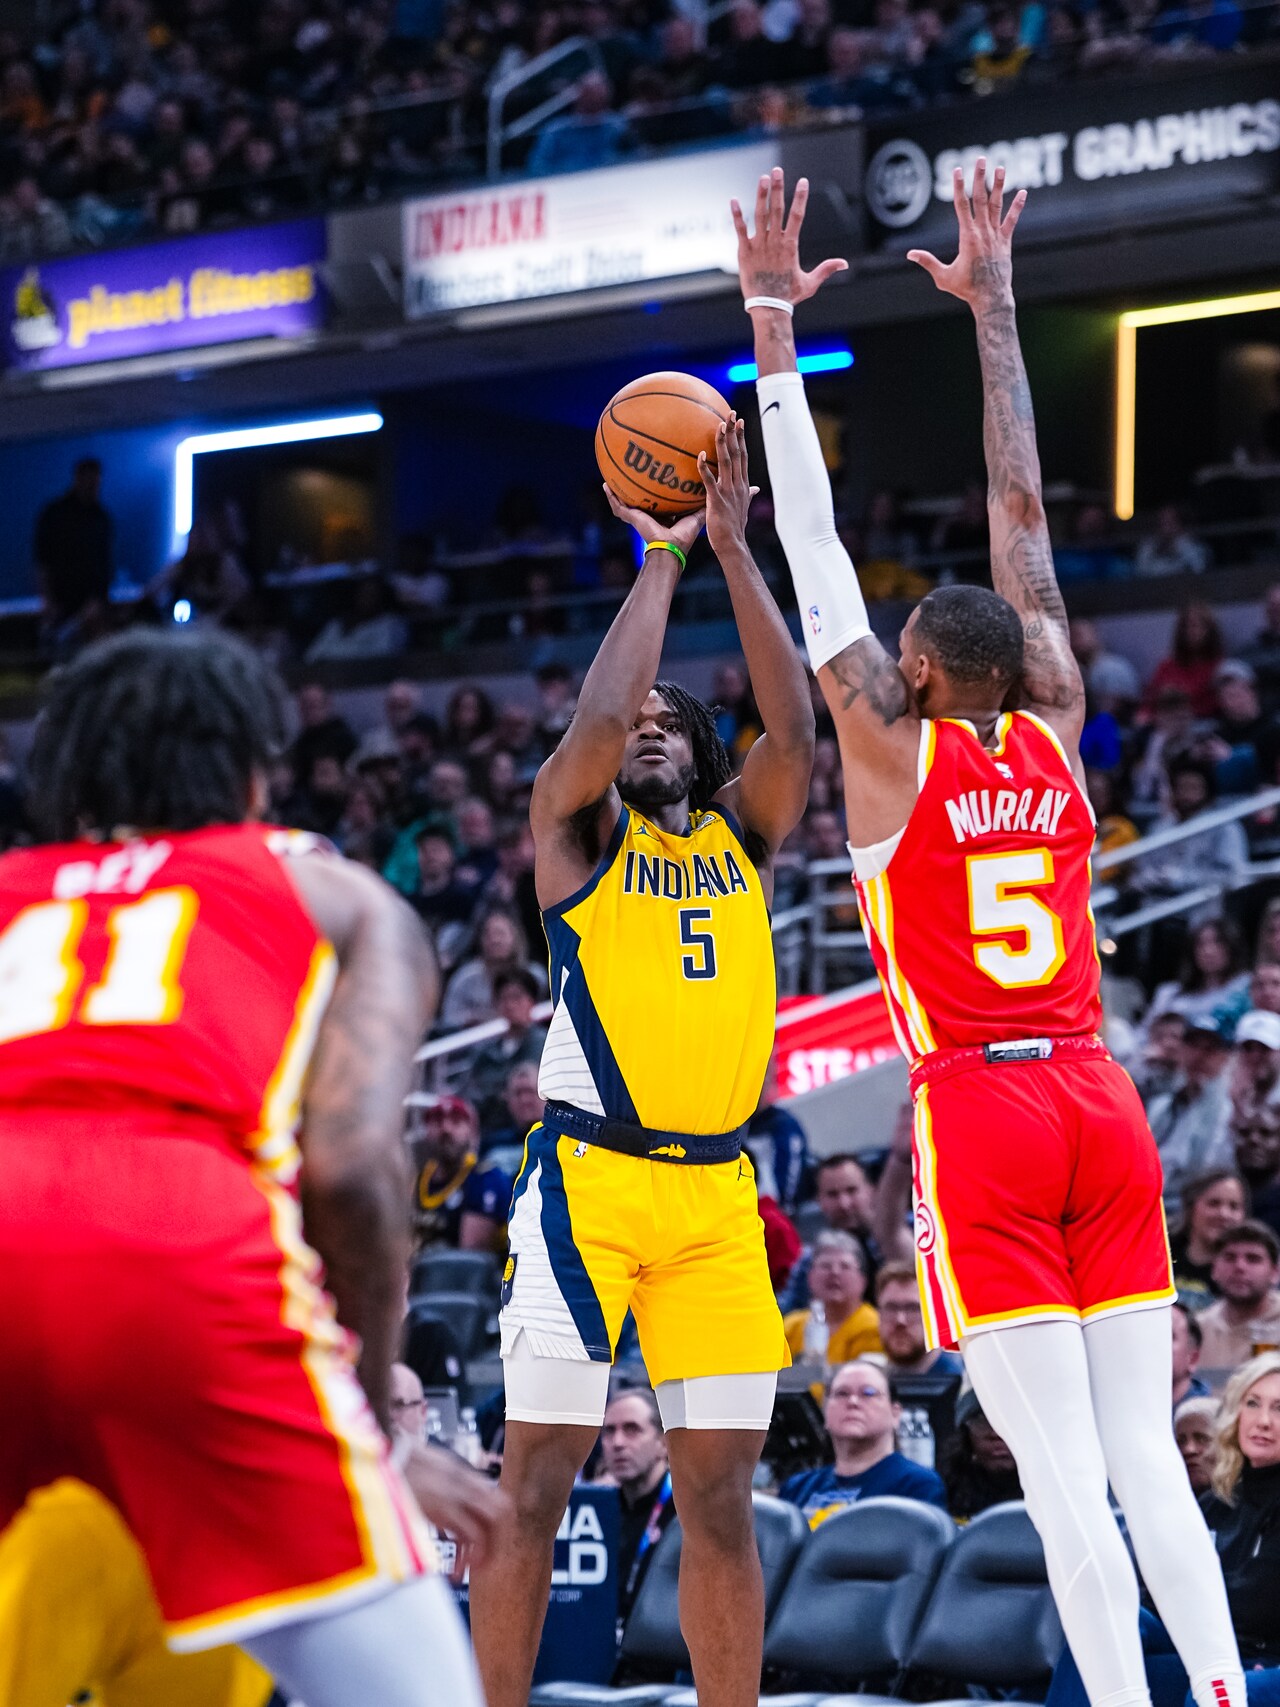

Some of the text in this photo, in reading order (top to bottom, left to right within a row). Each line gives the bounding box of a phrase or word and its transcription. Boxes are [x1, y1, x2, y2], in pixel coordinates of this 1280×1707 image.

[933, 98, 1280, 203] SPORT GRAPHICS
[413, 190, 546, 260] INDIANA
[66, 266, 315, 349] planet fitness
[623, 440, 706, 497] Wilson
[944, 788, 1071, 844] MURRAY
[623, 850, 748, 900] INDIANA
[678, 907, 718, 981] 5
[965, 847, 1067, 989] 5
[0, 885, 200, 1045] 41
